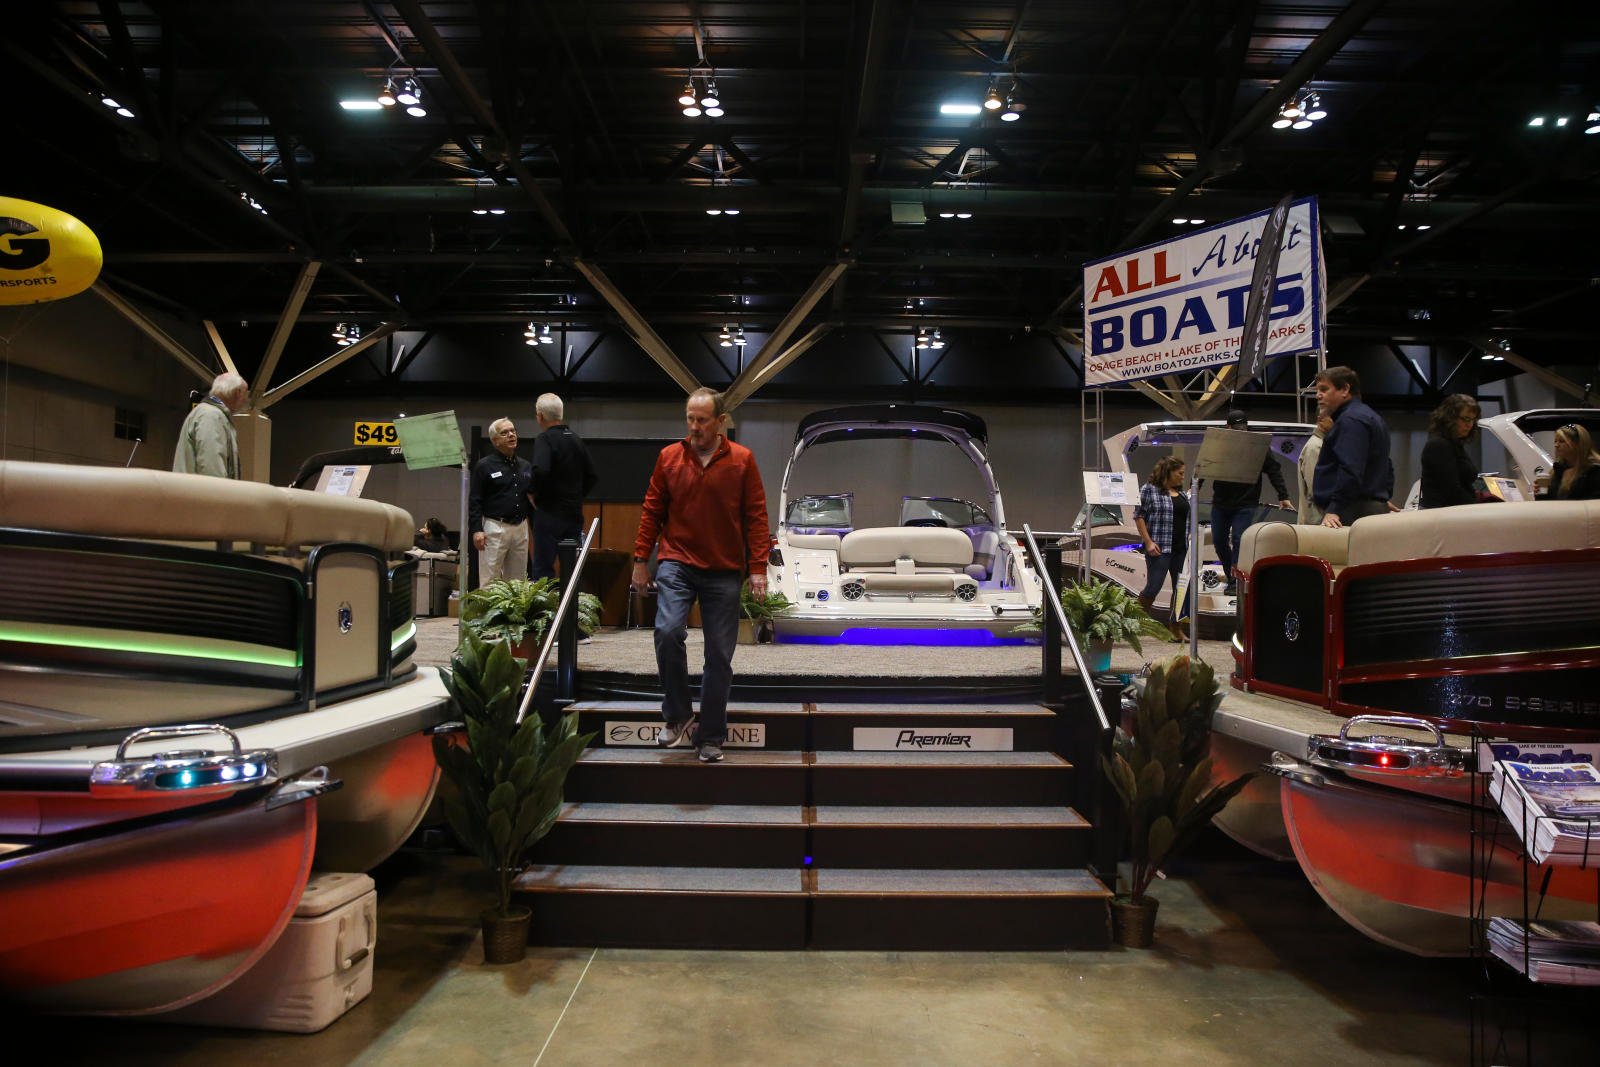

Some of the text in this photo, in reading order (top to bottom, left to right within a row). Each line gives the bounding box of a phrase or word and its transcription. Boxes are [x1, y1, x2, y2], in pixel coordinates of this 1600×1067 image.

[1091, 222, 1302, 303] ALL Abot
[0, 276, 57, 288] RSPORTS
[1089, 358, 1123, 373] OSAGE
[1125, 351, 1162, 367] BEACH
[1171, 344, 1202, 358] LAKE
[1204, 339, 1221, 352] OF
[1268, 323, 1306, 341] ARKS
[1121, 349, 1241, 378] WWW.BOATOZARKS.C
[356, 424, 401, 445] $49
